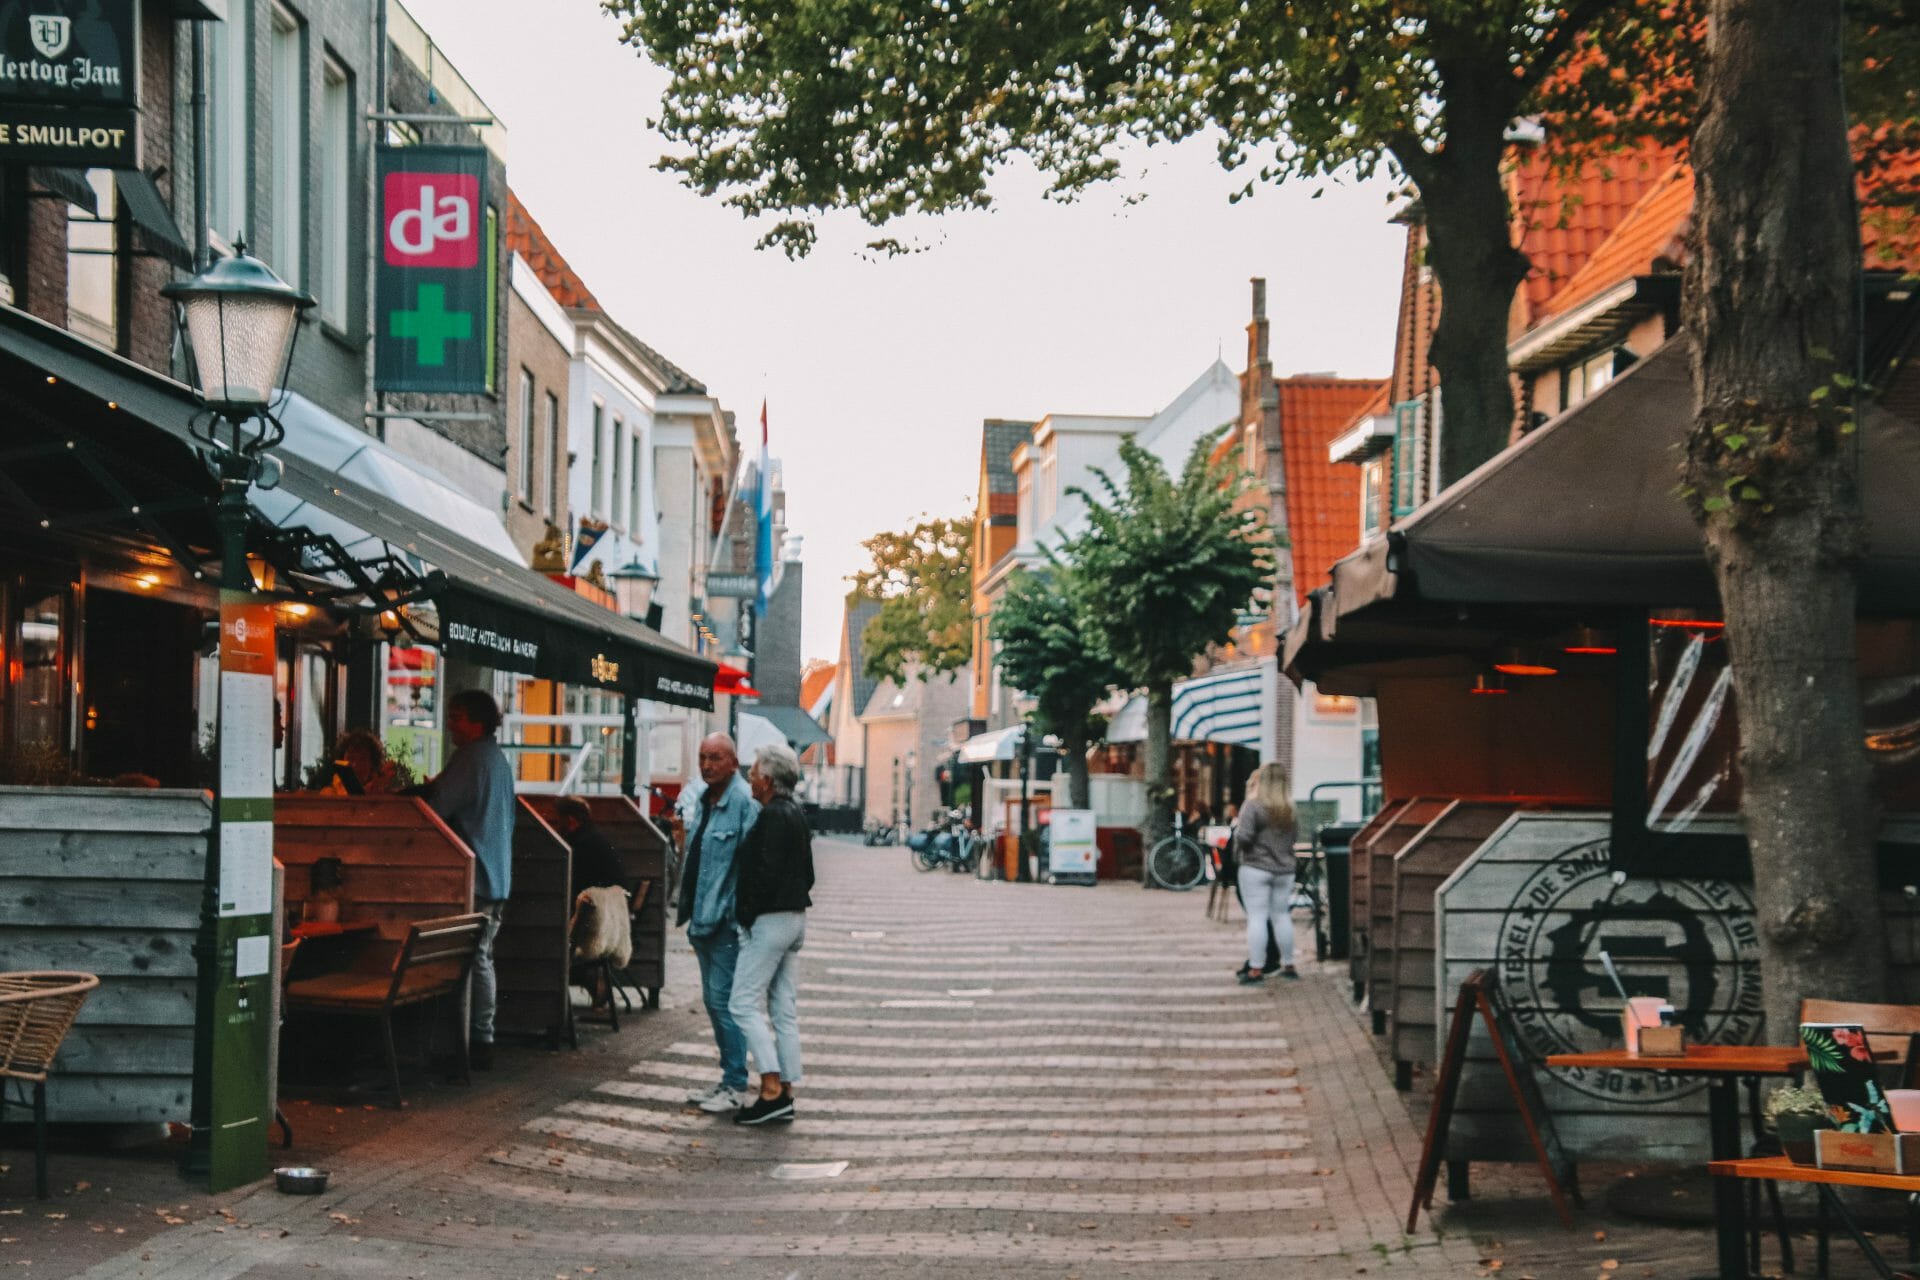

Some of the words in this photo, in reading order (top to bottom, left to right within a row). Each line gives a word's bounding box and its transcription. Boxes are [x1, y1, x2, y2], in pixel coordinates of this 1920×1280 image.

[71, 57, 121, 89] Jan
[16, 124, 125, 148] SMULPOT
[389, 184, 470, 255] da
[1530, 876, 1558, 906] DE
[1505, 923, 1534, 986] TEXEL
